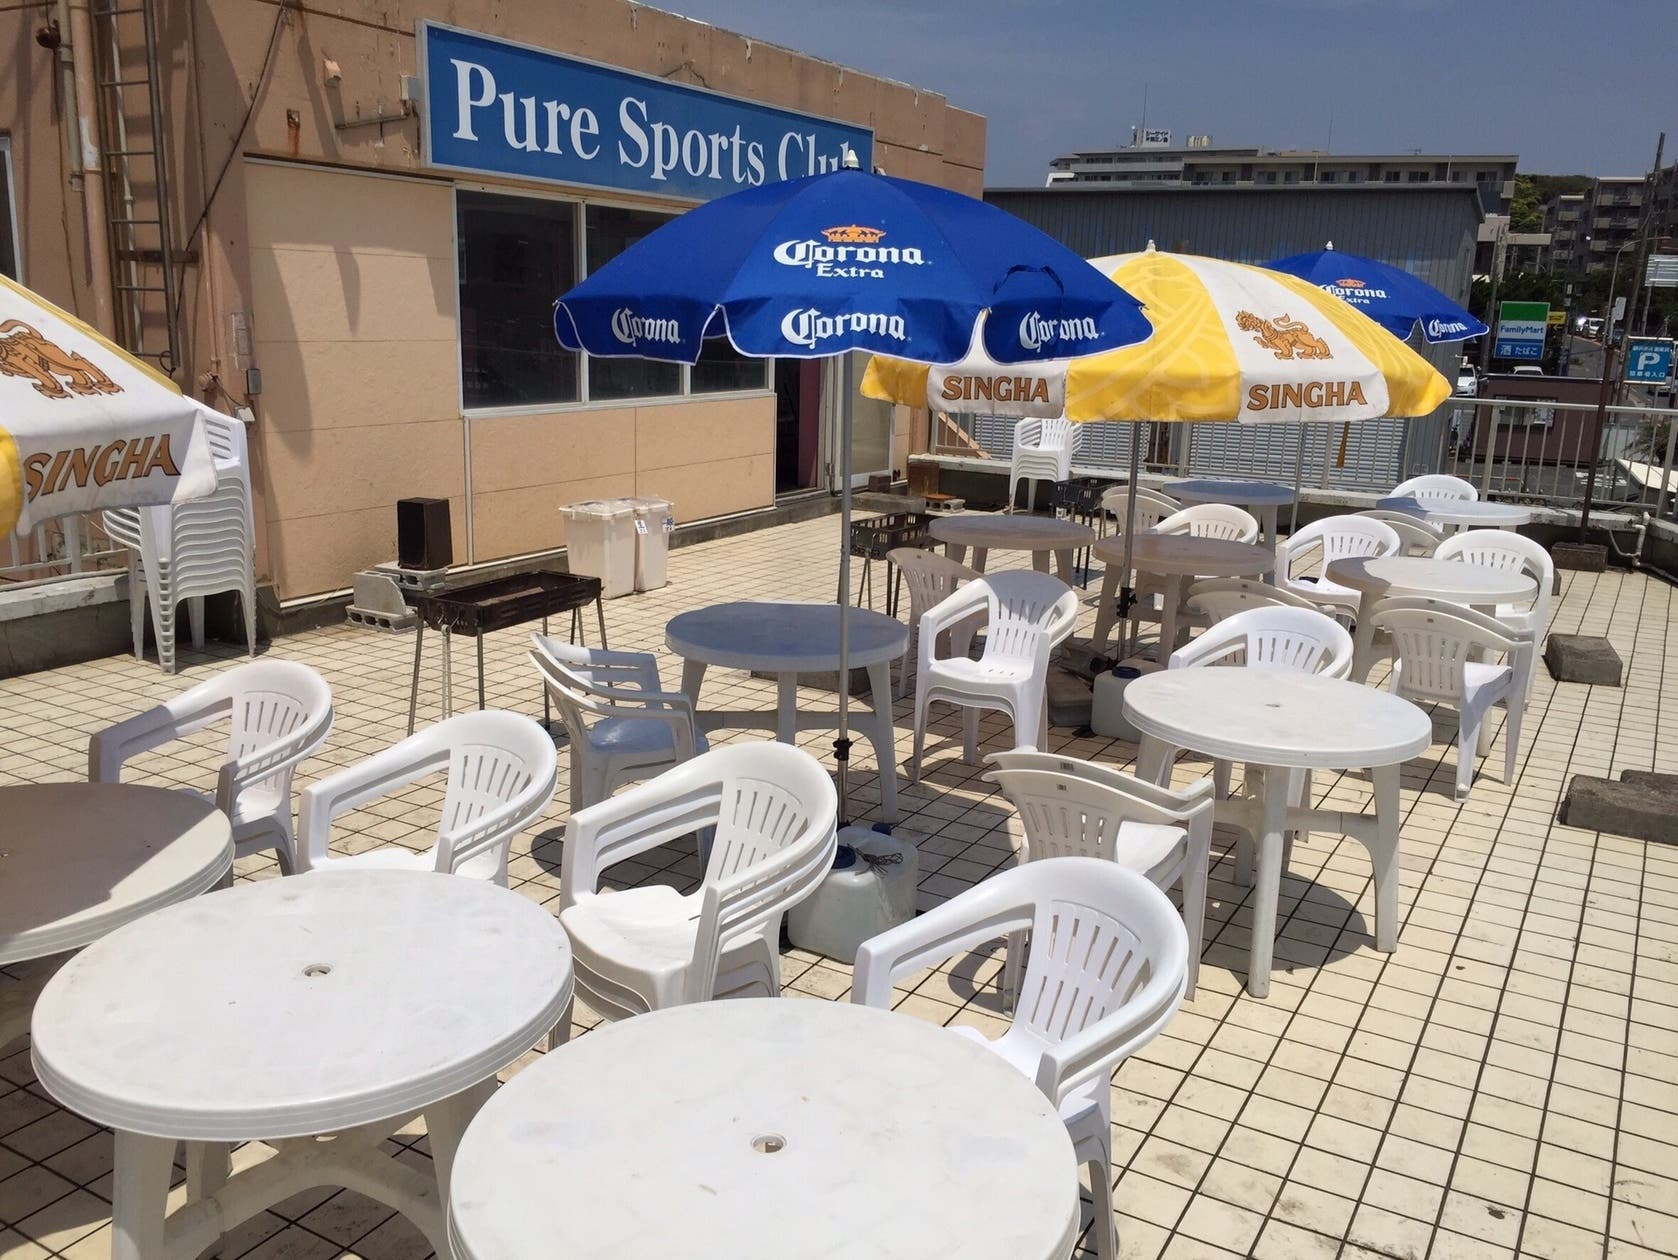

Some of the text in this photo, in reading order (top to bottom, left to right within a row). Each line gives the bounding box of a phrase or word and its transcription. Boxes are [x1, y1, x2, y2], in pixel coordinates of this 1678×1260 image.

[450, 58, 600, 161] Pure
[618, 97, 765, 187] Sports
[773, 239, 925, 269] Corona
[816, 262, 884, 279] Extra
[611, 307, 681, 347] Corona
[781, 307, 906, 350] Corona
[1019, 310, 1100, 353] Corona
[1500, 325, 1544, 335] FamilyMart
[1638, 352, 1660, 370] P
[942, 375, 1050, 402] SINGHA
[1247, 381, 1369, 411] SINGHA
[23, 434, 181, 504] SINGHA
